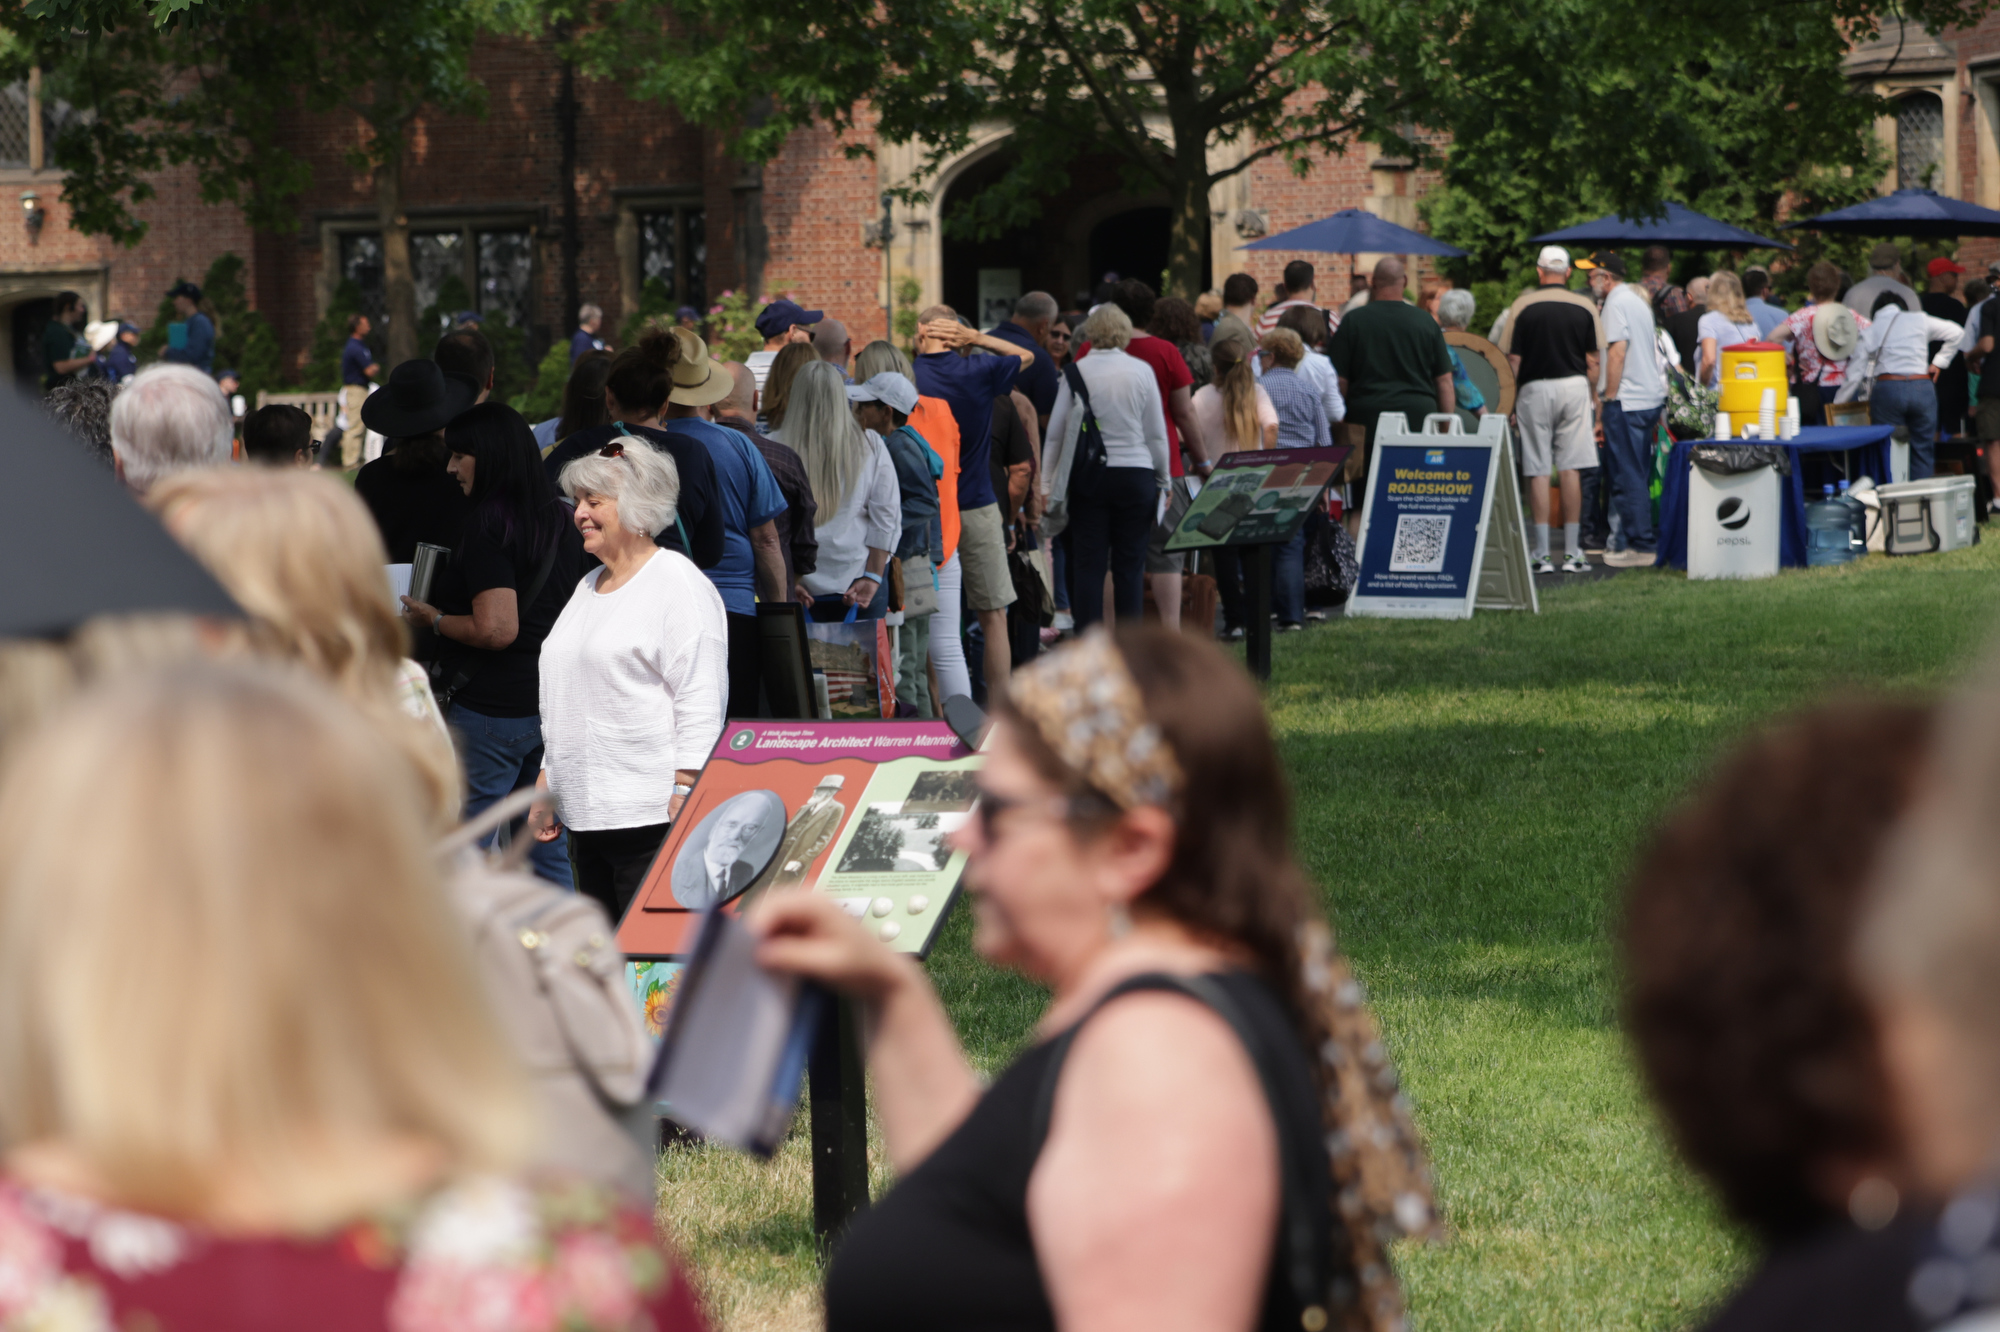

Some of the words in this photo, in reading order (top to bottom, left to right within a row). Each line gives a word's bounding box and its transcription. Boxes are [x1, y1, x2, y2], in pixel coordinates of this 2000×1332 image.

[1395, 469, 1454, 480] Welcome
[1456, 470, 1470, 481] to
[1388, 483, 1473, 495] ROADSHOW!
[1717, 536, 1748, 548] pepsi
[736, 735, 747, 746] 2
[756, 737, 818, 750] Landscape
[818, 736, 873, 748] Architect
[873, 735, 912, 747] Warren
[914, 735, 959, 747] Manning
